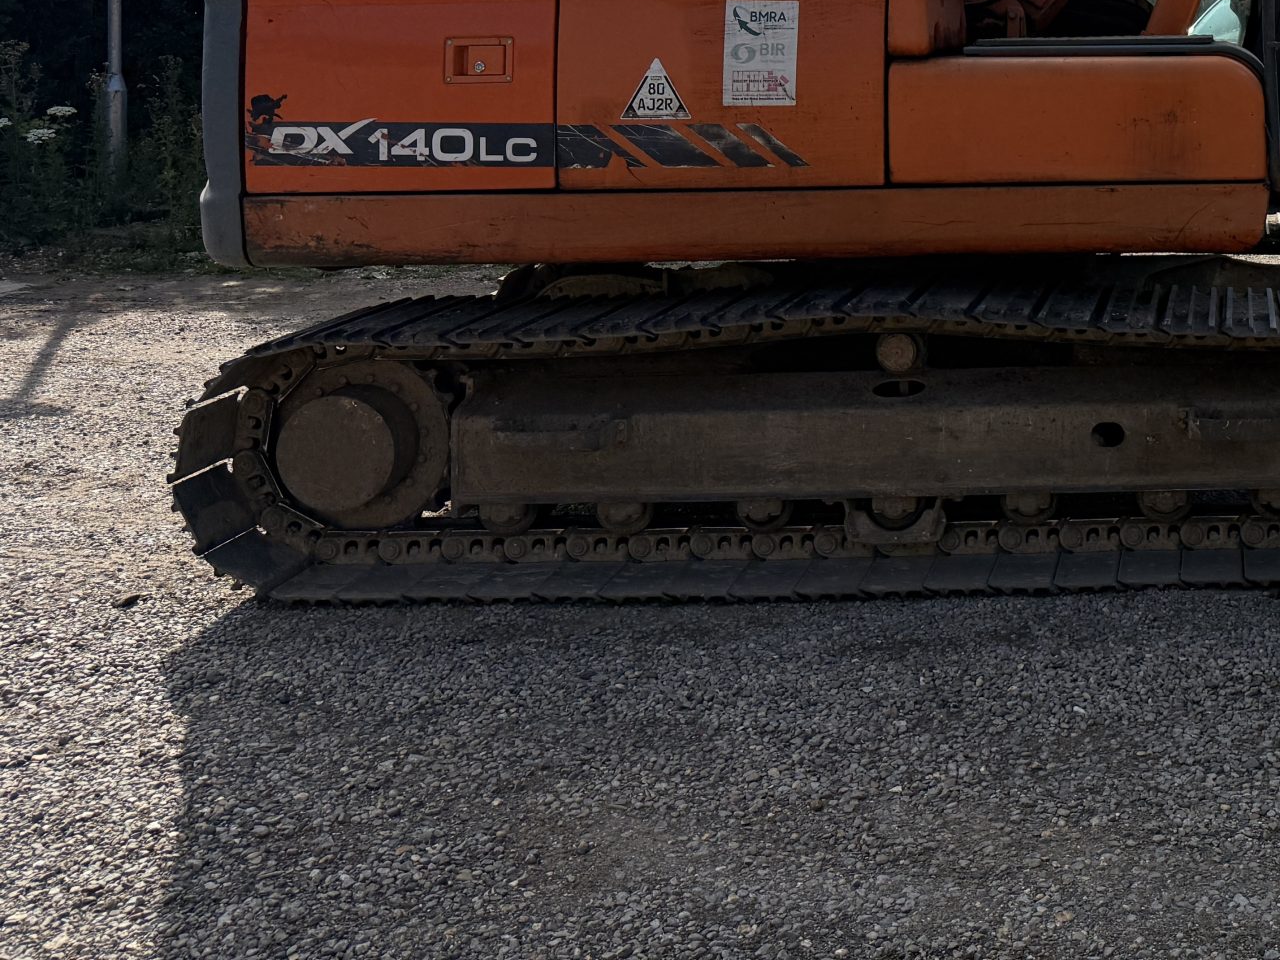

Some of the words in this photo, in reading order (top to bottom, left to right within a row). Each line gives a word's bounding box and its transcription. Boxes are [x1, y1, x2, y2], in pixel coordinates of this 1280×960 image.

[750, 11, 787, 22] BMRA
[760, 43, 786, 57] BIR
[637, 97, 673, 111] AJ2R
